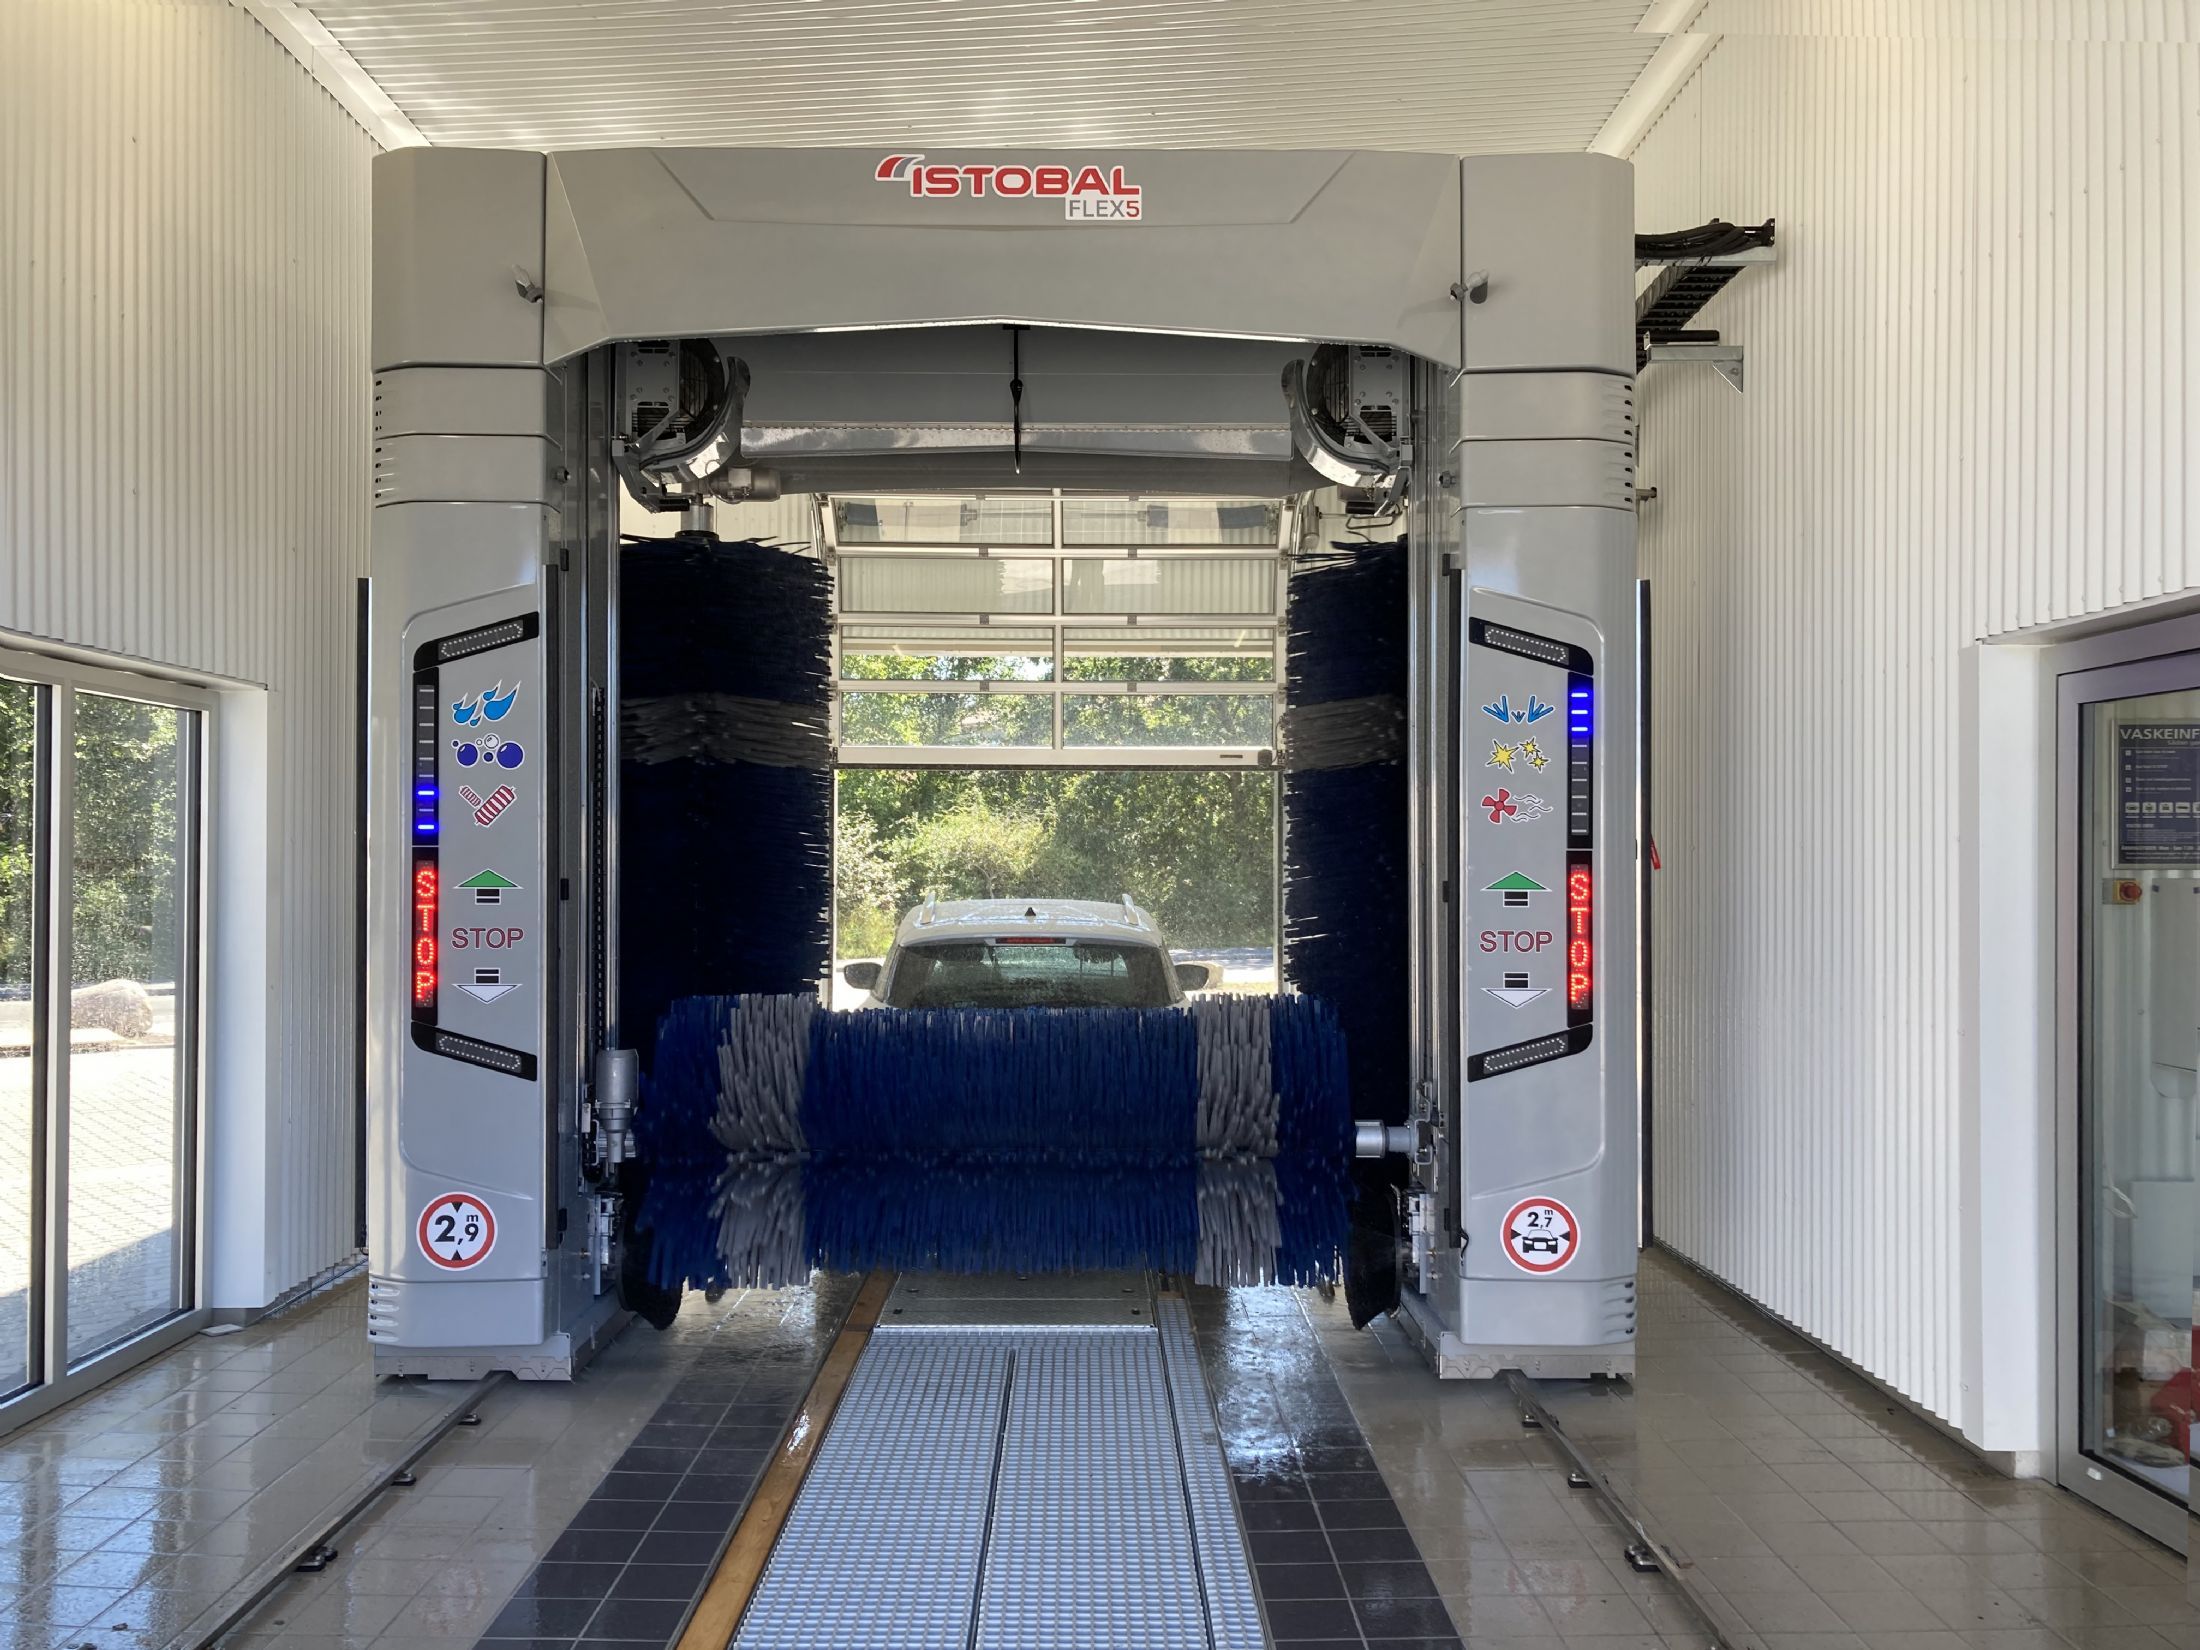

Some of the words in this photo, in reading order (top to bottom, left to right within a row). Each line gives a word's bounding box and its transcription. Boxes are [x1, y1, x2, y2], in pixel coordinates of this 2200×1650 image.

[912, 167, 1140, 196] ISTOBAL
[1069, 200, 1140, 218] FLEX5
[416, 870, 436, 999] STOP
[451, 927, 524, 949] STOP
[1479, 930, 1553, 952] STOP
[1570, 873, 1589, 1002] STOP
